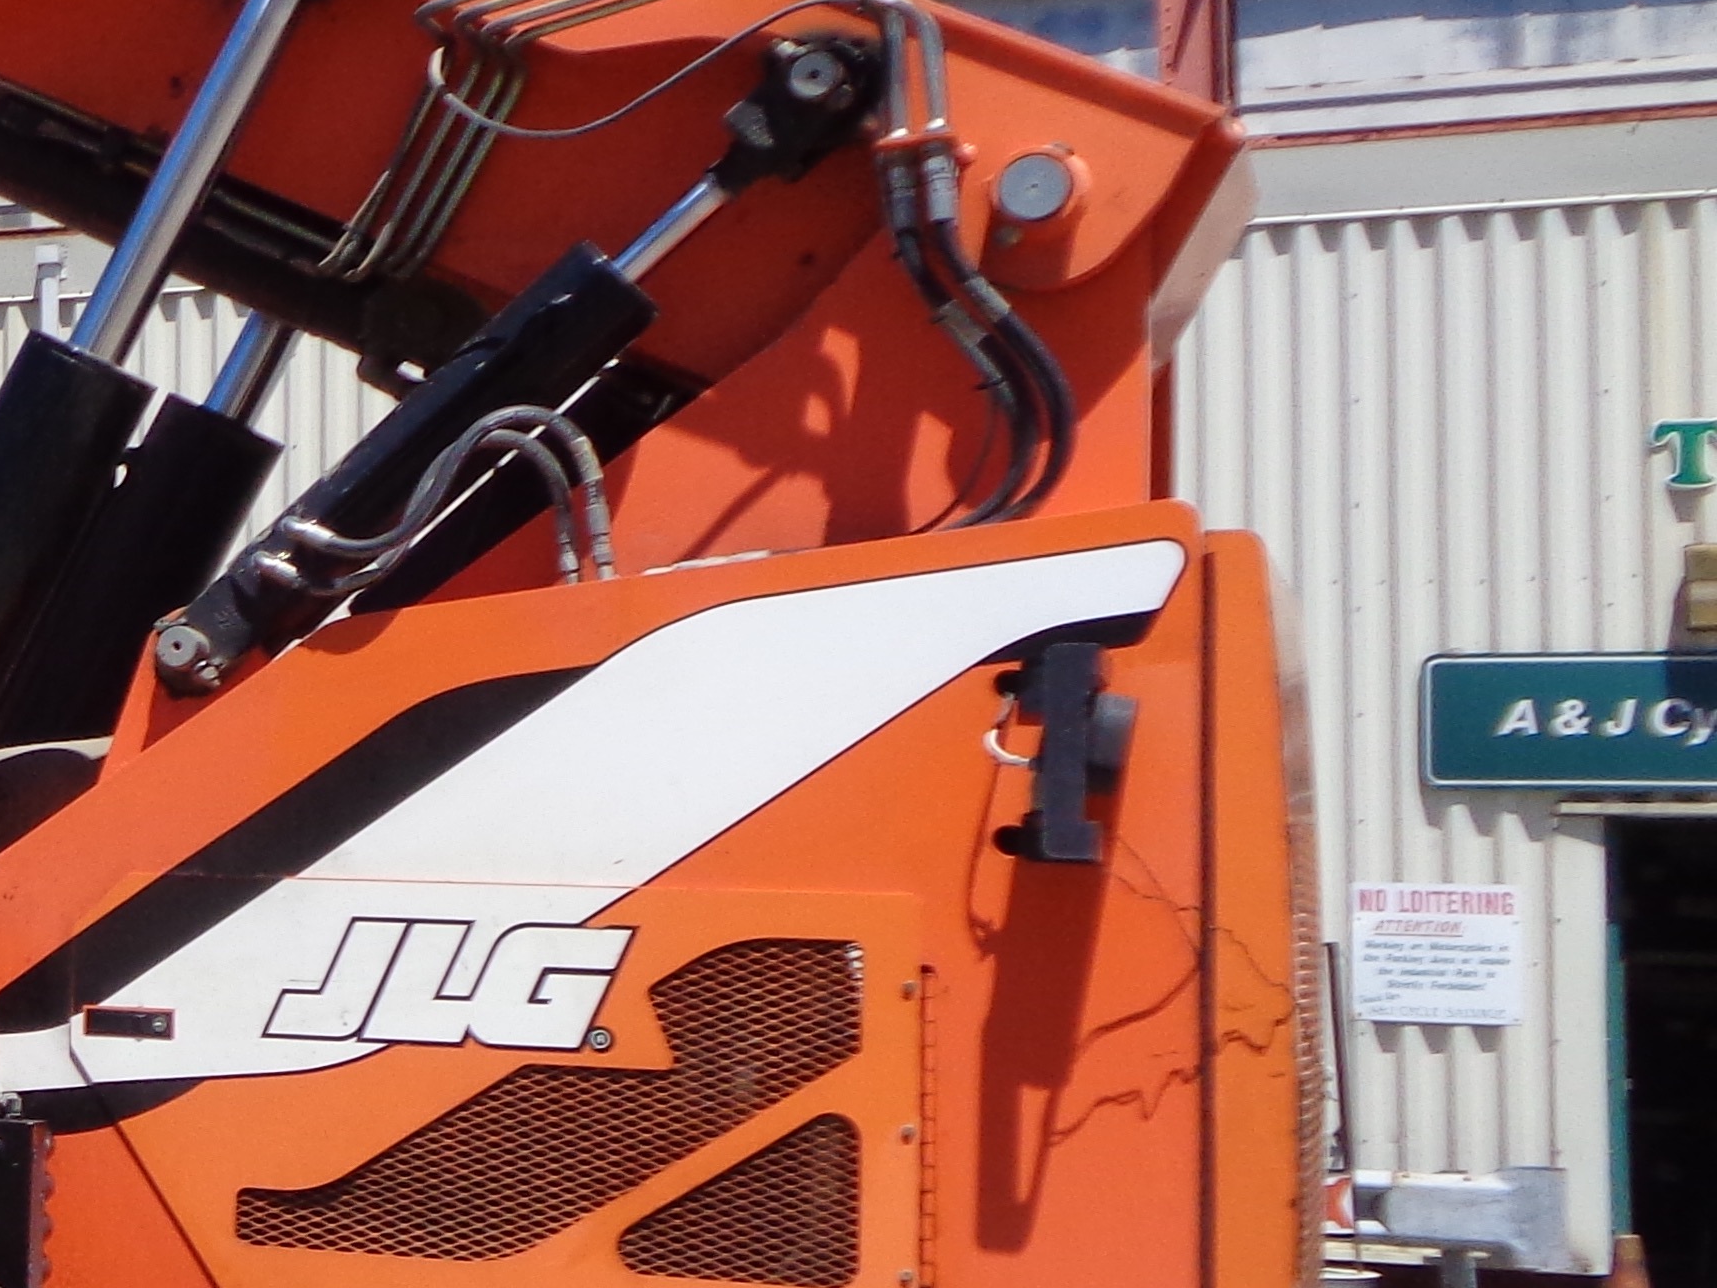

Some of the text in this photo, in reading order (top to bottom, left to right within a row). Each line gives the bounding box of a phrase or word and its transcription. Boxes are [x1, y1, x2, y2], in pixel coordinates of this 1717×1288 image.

[1650, 418, 1717, 488] T
[1359, 889, 1515, 915] NO LOITERING
[260, 917, 639, 1050] JLG
